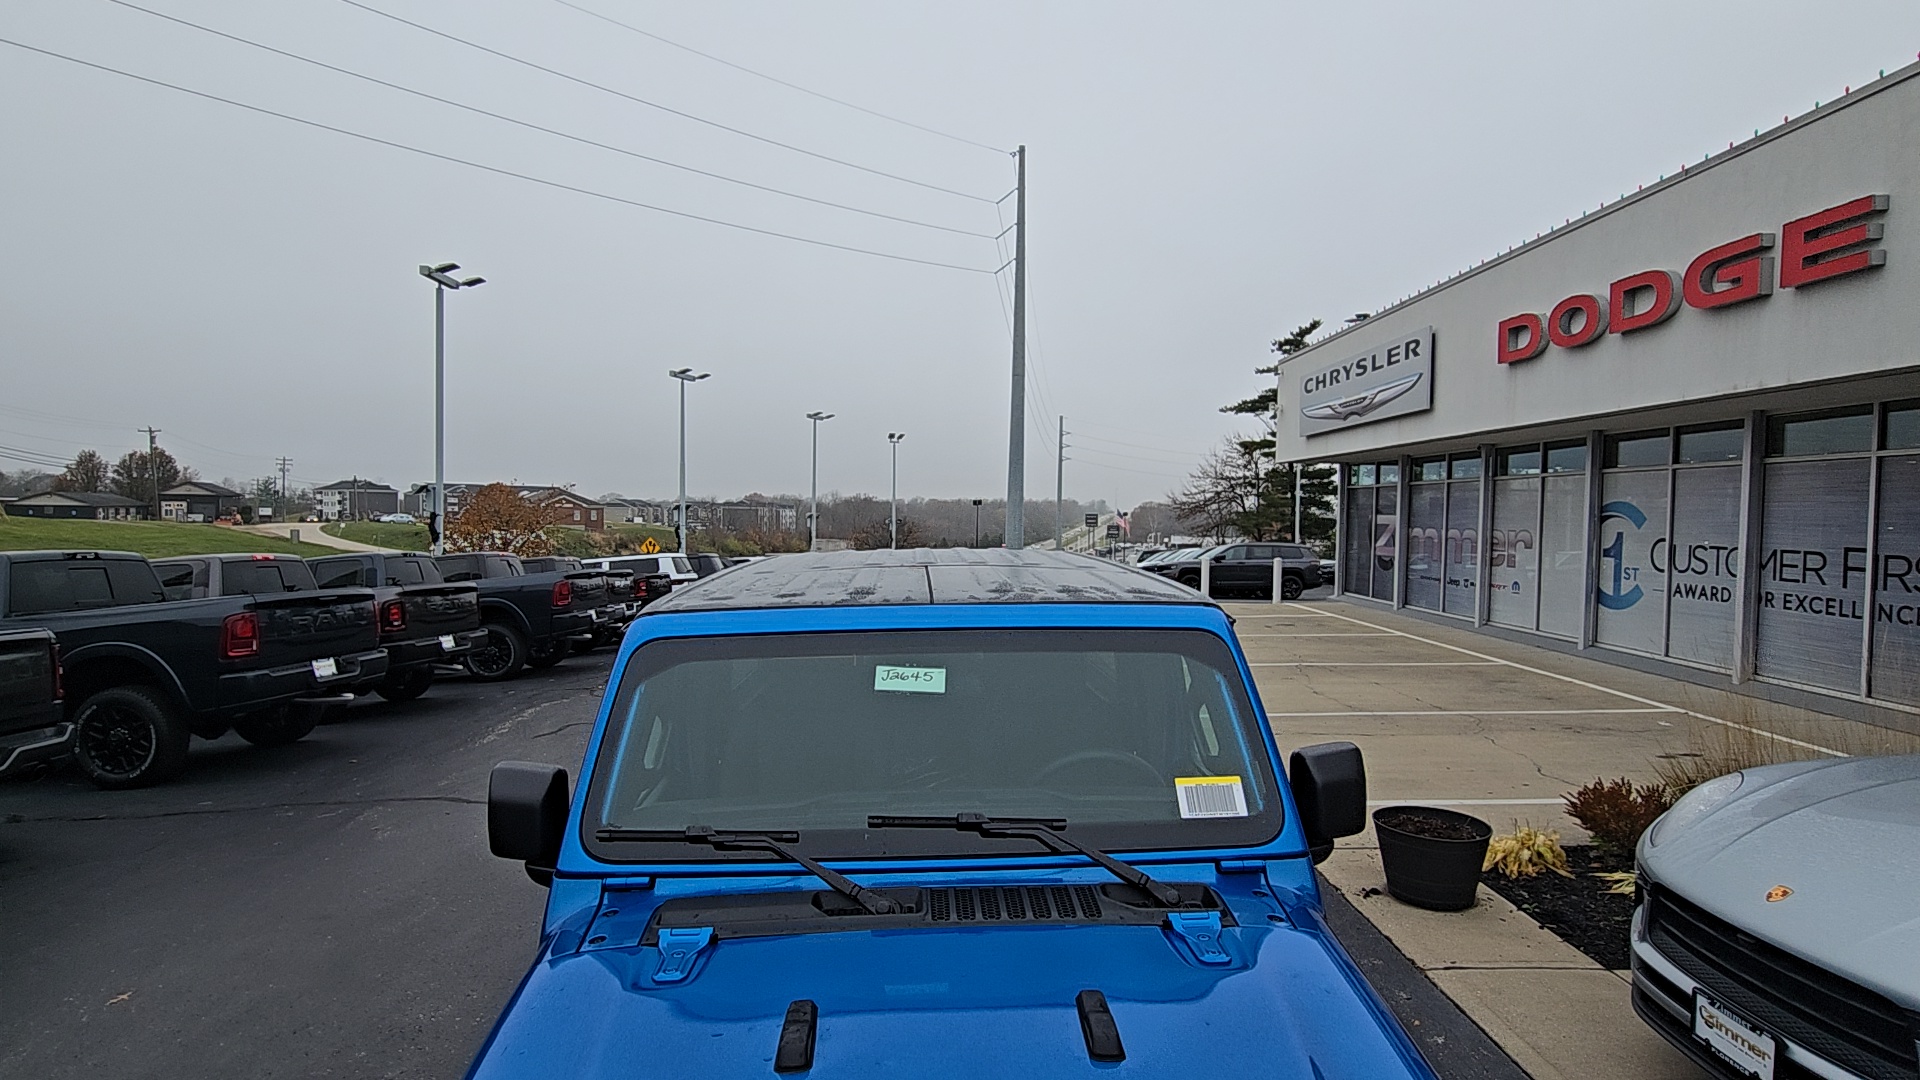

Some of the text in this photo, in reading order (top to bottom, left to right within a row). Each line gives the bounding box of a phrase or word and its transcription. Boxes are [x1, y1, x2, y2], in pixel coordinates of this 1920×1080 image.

[1498, 195, 1889, 364] DODGE
[1304, 339, 1420, 394] CHRYSLER
[1673, 583, 1732, 602] AWARD
[1783, 593, 1920, 626] EXCELLNC
[881, 669, 934, 682] J2645
